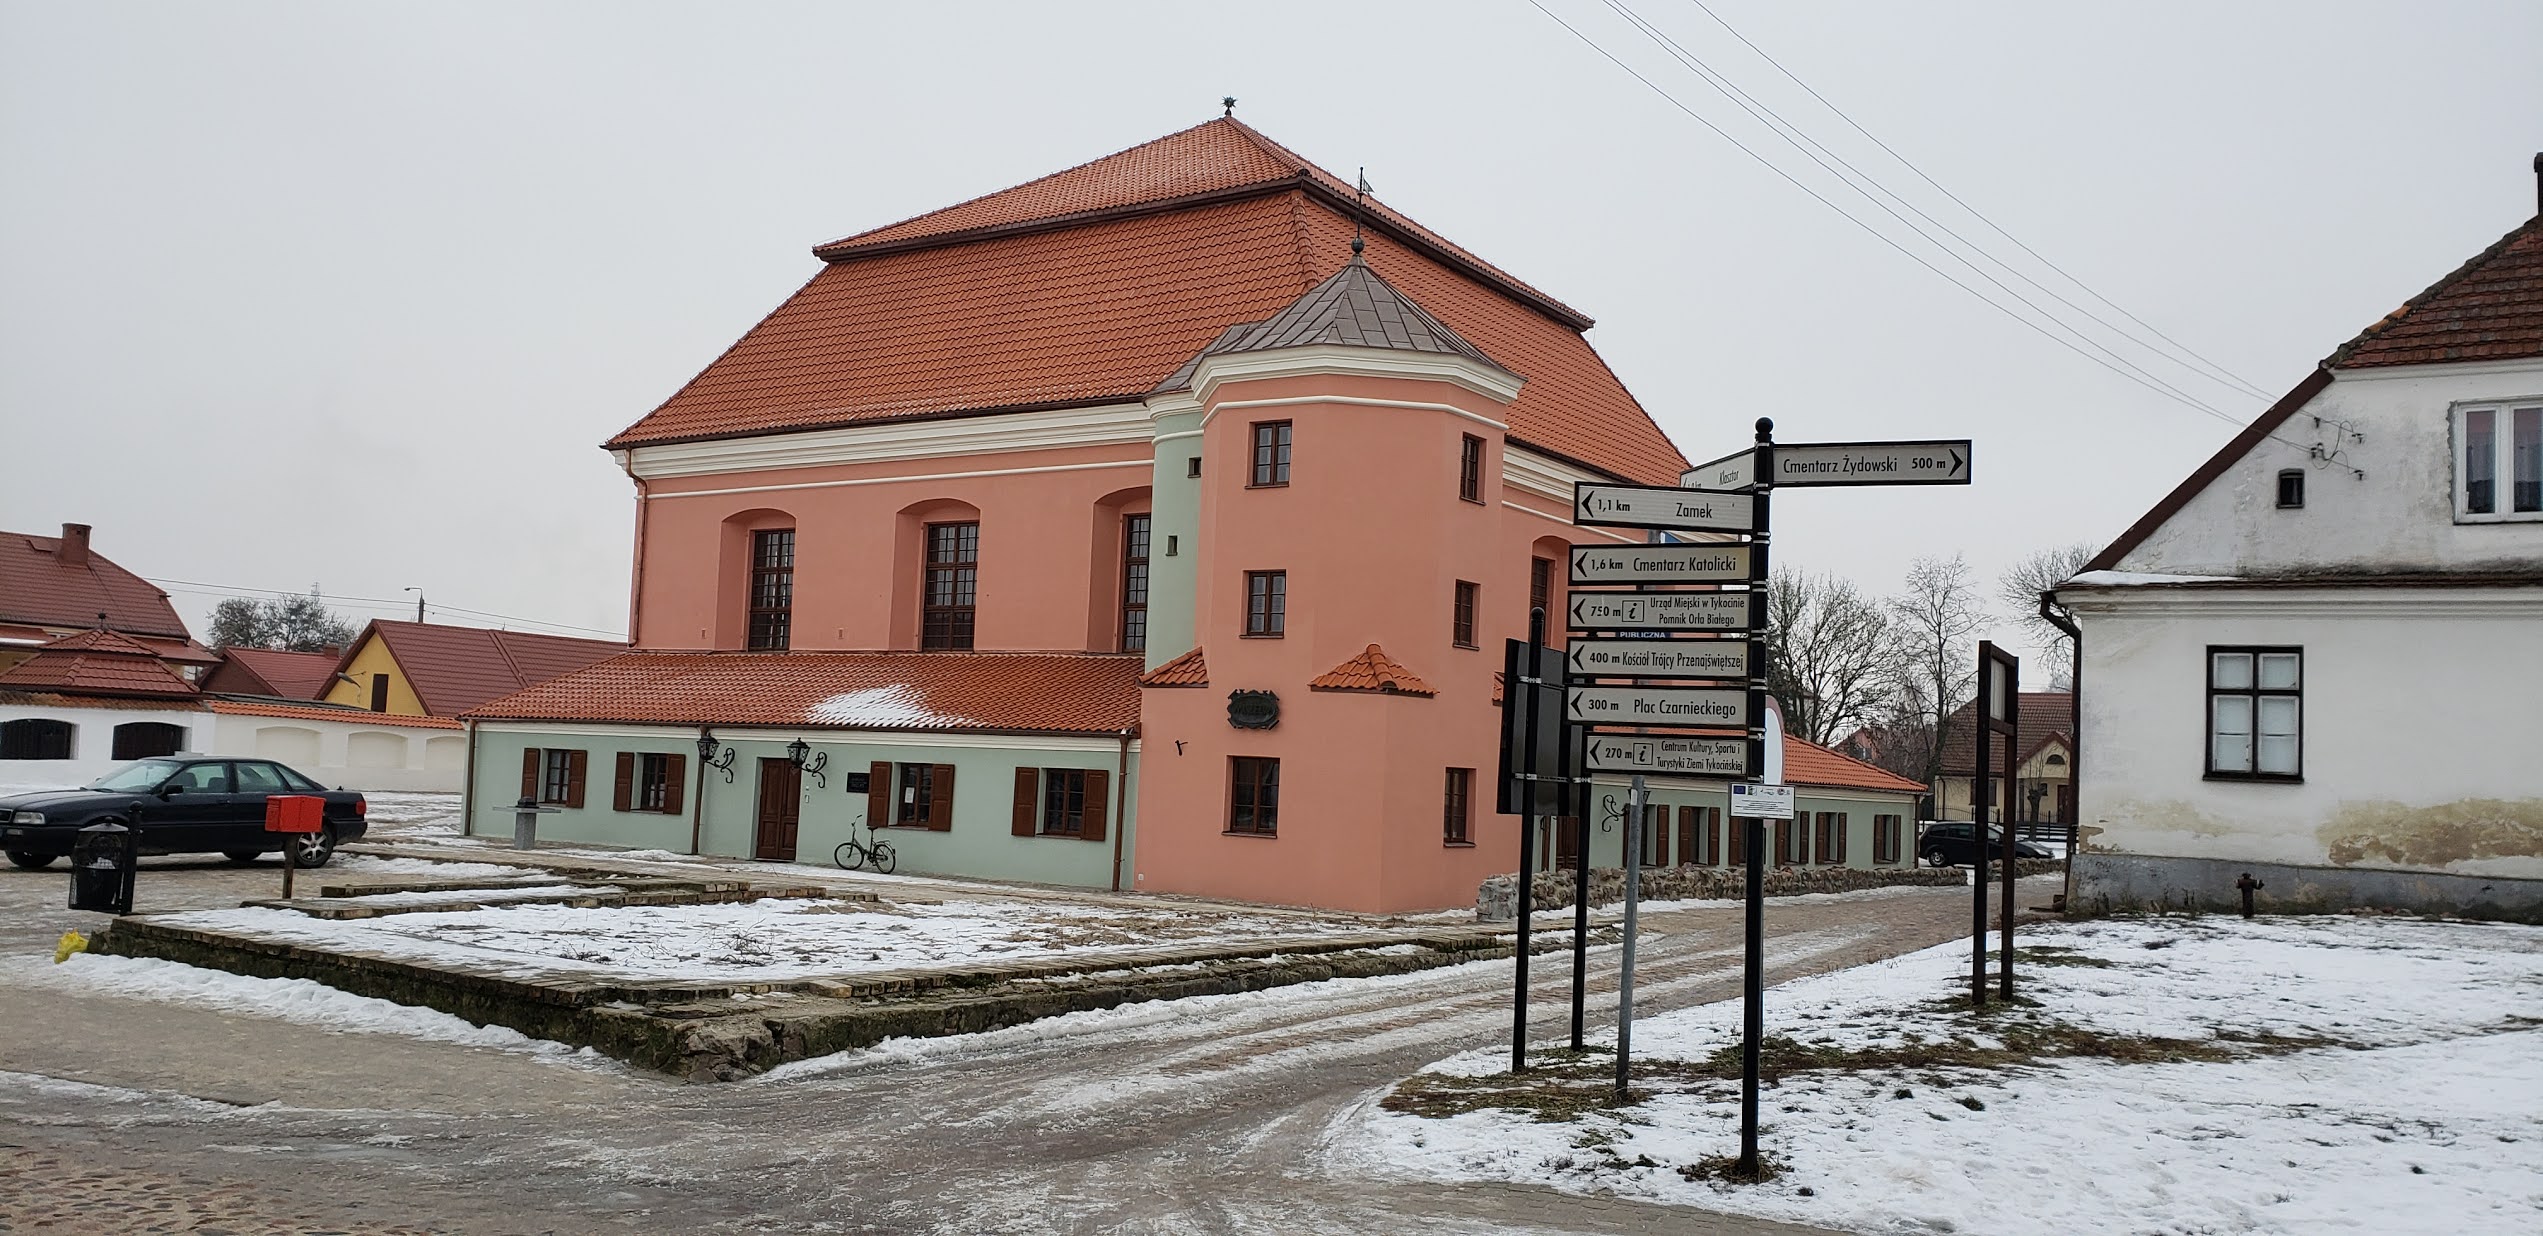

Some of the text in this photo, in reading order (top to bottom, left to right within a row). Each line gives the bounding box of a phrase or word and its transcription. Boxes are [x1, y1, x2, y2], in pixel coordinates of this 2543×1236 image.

[1783, 454, 1946, 476] Cmentarz Żydowski 500 m
[1597, 499, 1631, 512] 1,1 km
[1675, 502, 1713, 519] Zamek
[1590, 558, 1624, 572] 1,6 km
[1633, 555, 1737, 572] Cmentarz Katolicki
[1590, 605, 1621, 617] 750 m
[1650, 597, 1745, 611] Urząd Miejski w Tykocinie
[1659, 613, 1735, 627] Pomnik Orła Białego
[1619, 631, 1666, 639] PUBLICZNA
[1589, 652, 1621, 664] 400 m
[1622, 650, 1744, 672] Kościół Trójcy Przenajświętszej
[1588, 699, 1619, 711] 300 m
[1633, 698, 1736, 719] Plac Czarnieckiego
[1605, 748, 1633, 759] 270 m
[1661, 740, 1687, 753] Centrum
[1715, 743, 1736, 757] Sportu
[1656, 756, 1744, 774] Turystyki Ziemi Tykocińskiej
